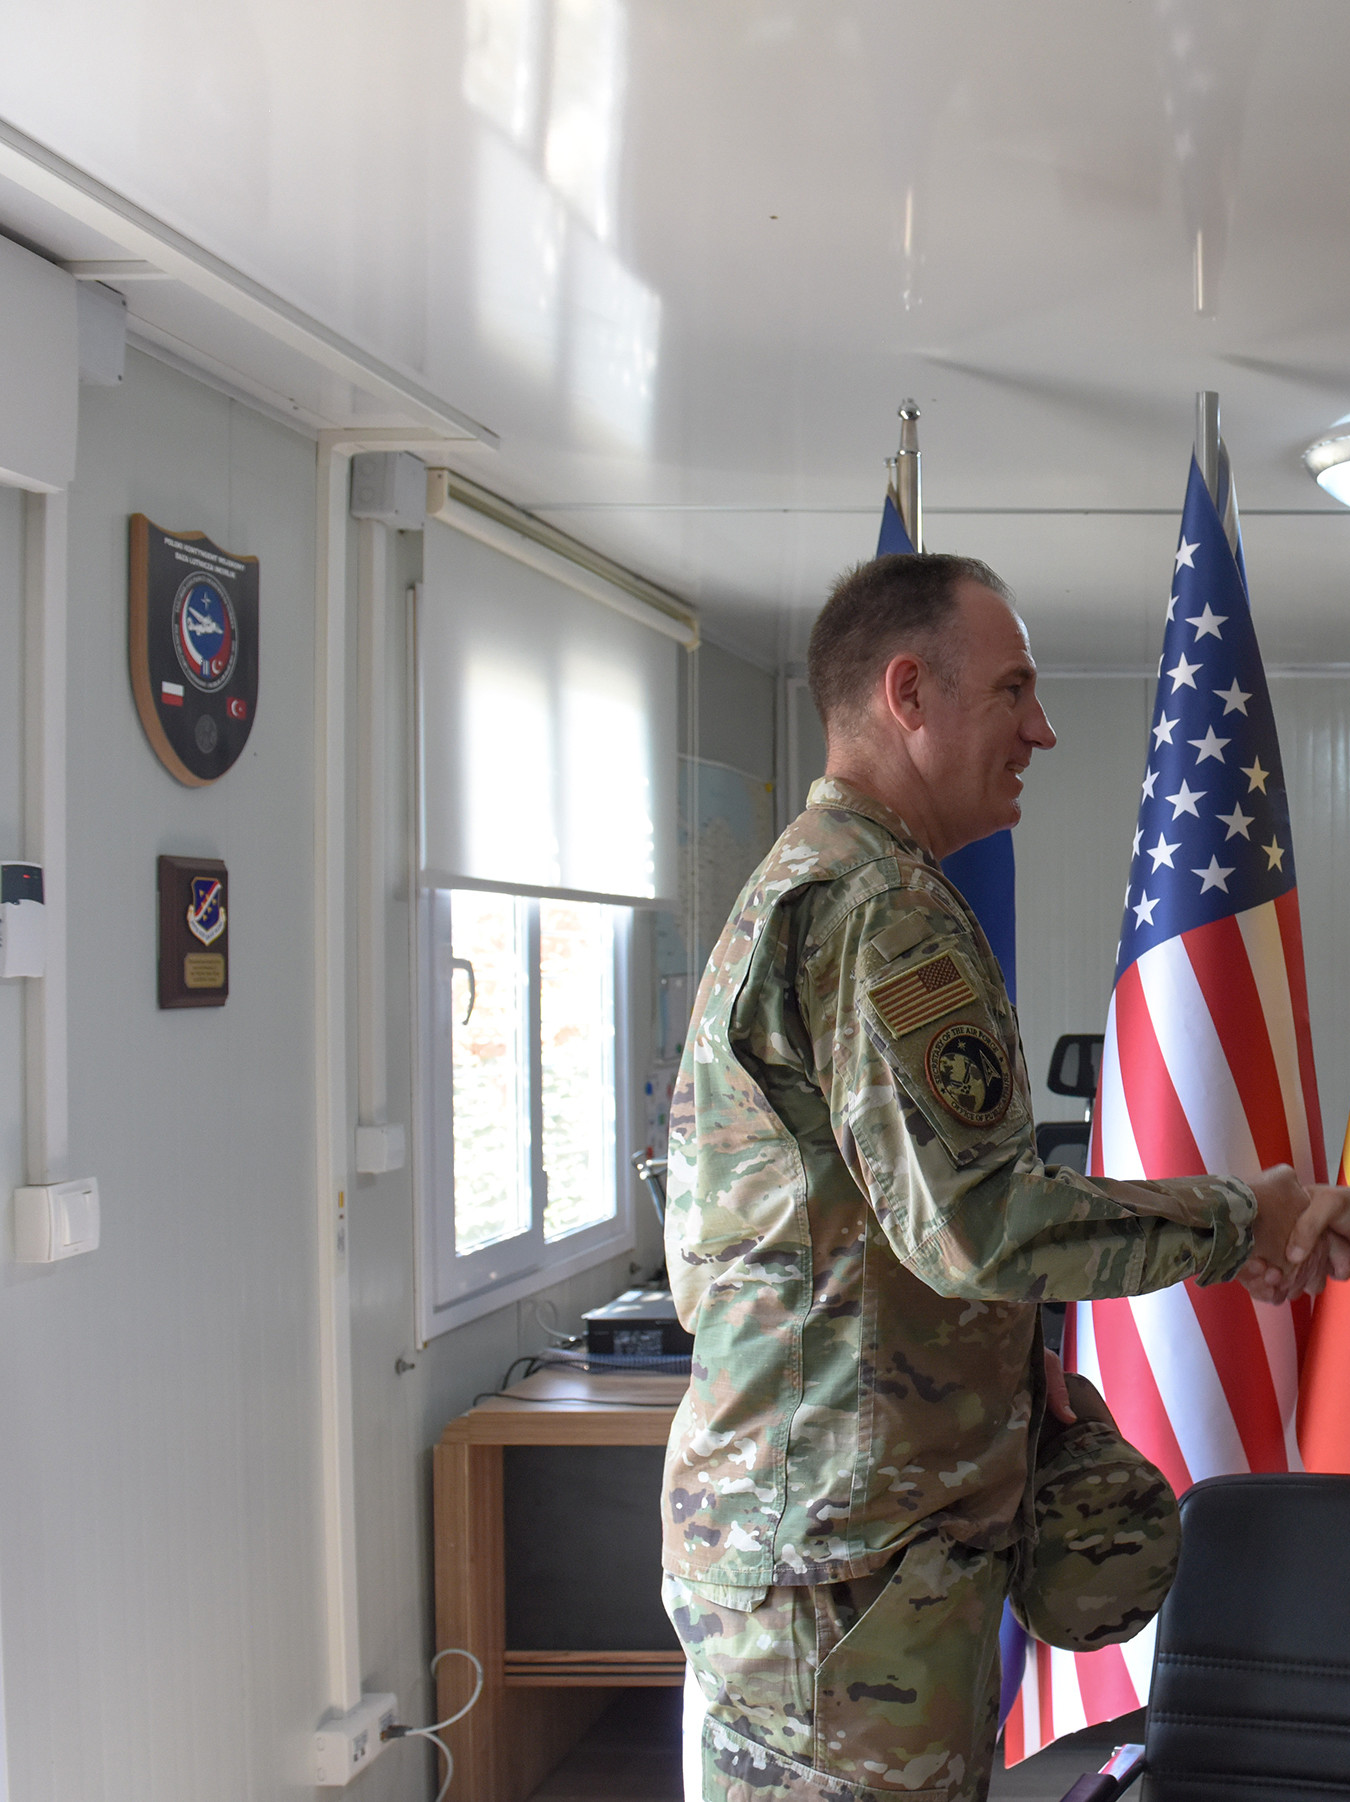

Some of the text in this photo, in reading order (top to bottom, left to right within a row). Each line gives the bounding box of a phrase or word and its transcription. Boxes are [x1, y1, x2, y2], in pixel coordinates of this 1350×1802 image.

[931, 1027, 999, 1084] SECRETARY OF THE AIR FORCE
[951, 1101, 975, 1121] OFFICE
[975, 1114, 984, 1122] OF
